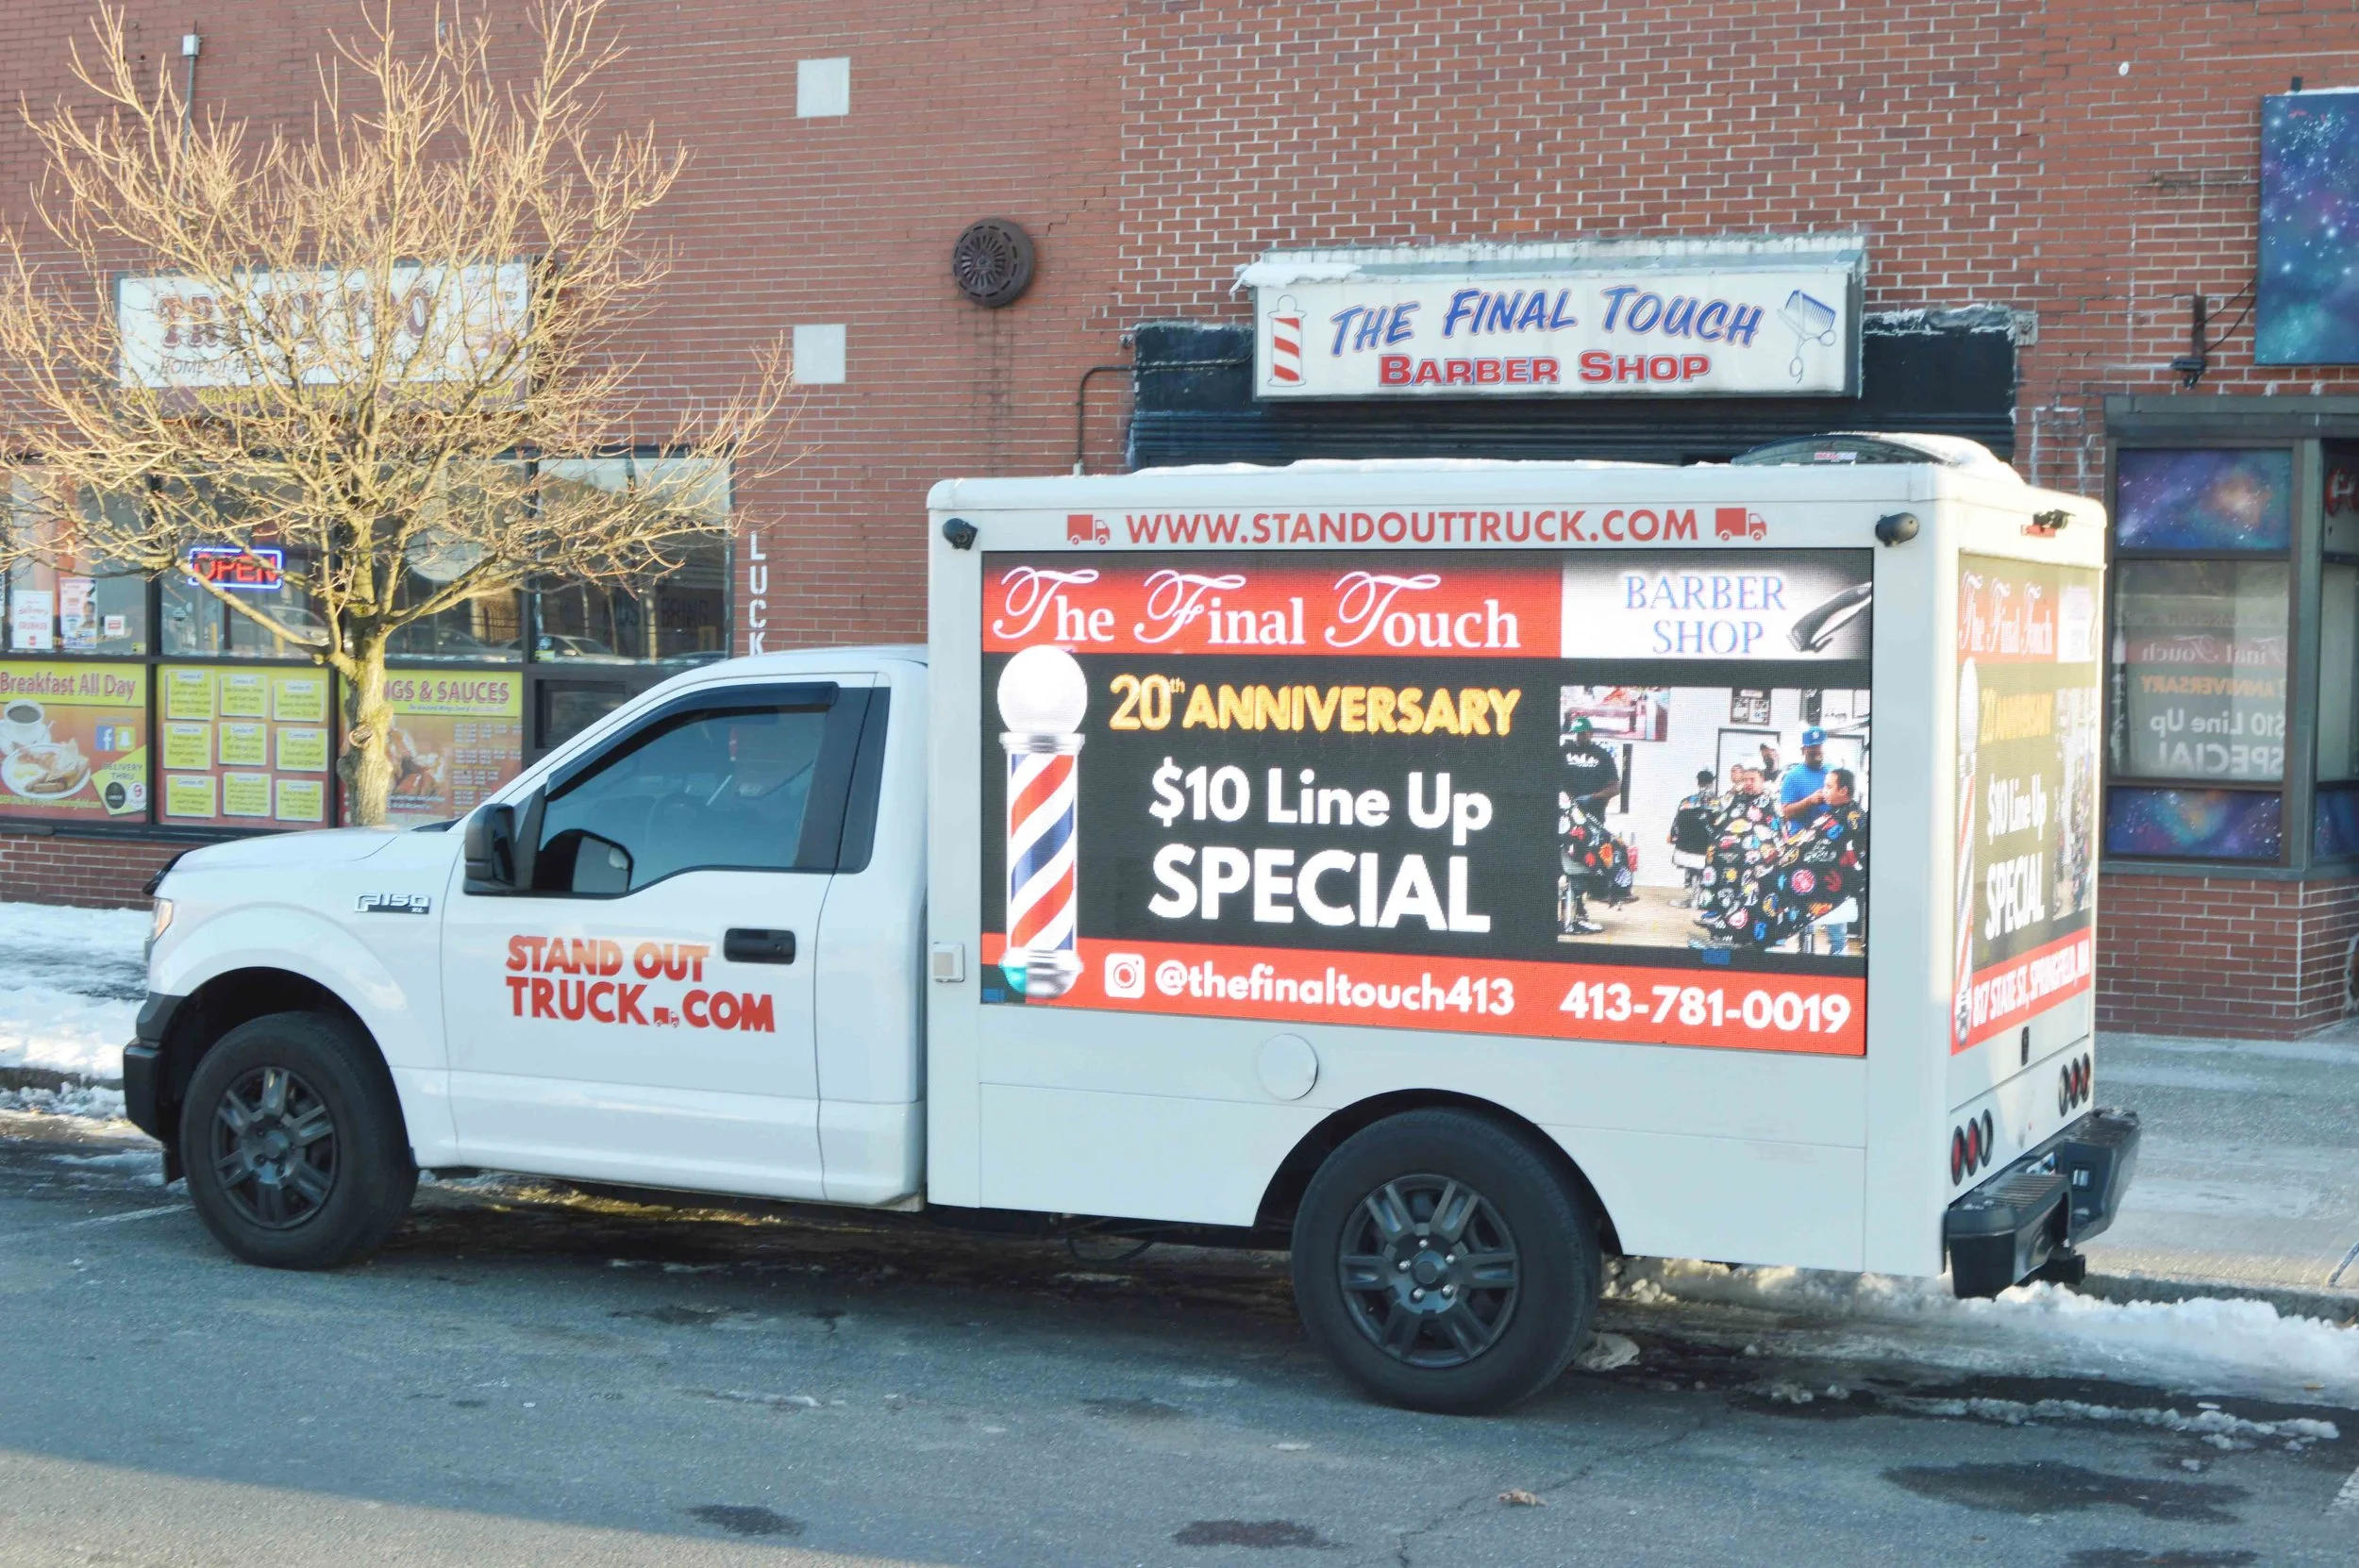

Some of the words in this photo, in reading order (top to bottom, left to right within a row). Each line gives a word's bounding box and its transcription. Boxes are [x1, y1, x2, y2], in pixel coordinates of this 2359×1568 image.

[1330, 301, 1420, 359] THE
[1442, 288, 1581, 339] FINAL
[1601, 284, 1765, 349] TOUCH
[1379, 353, 1560, 388] BARBER
[1579, 349, 1712, 385] SHOP
[1126, 509, 1699, 544] WWW.STANDOUTTRUCK.COM
[194, 552, 278, 583] OPEN
[992, 566, 1115, 642] The
[1133, 569, 1306, 645] Final
[1324, 571, 1521, 650] Touch
[1625, 574, 1787, 611] BARBER
[1652, 619, 1764, 654] SHOP
[0, 671, 75, 696] Breakfast
[79, 673, 100, 697] All
[104, 674, 137, 704] Day
[420, 680, 433, 703] &
[437, 680, 510, 705] SAUCES
[1109, 674, 1185, 731] 20th
[1181, 683, 1522, 737] ANNIVERSARY
[1148, 756, 1251, 827] $10
[1267, 768, 1391, 827] Line
[1408, 772, 1493, 846] Up
[1147, 842, 1491, 933] SPECIAL
[1984, 851, 2046, 941] SPECIAL
[505, 934, 624, 976] STAND
[633, 942, 710, 983] OUT
[1154, 959, 1515, 1016] @thefinaltouch413
[1559, 980, 1852, 1034] 413-781-0019
